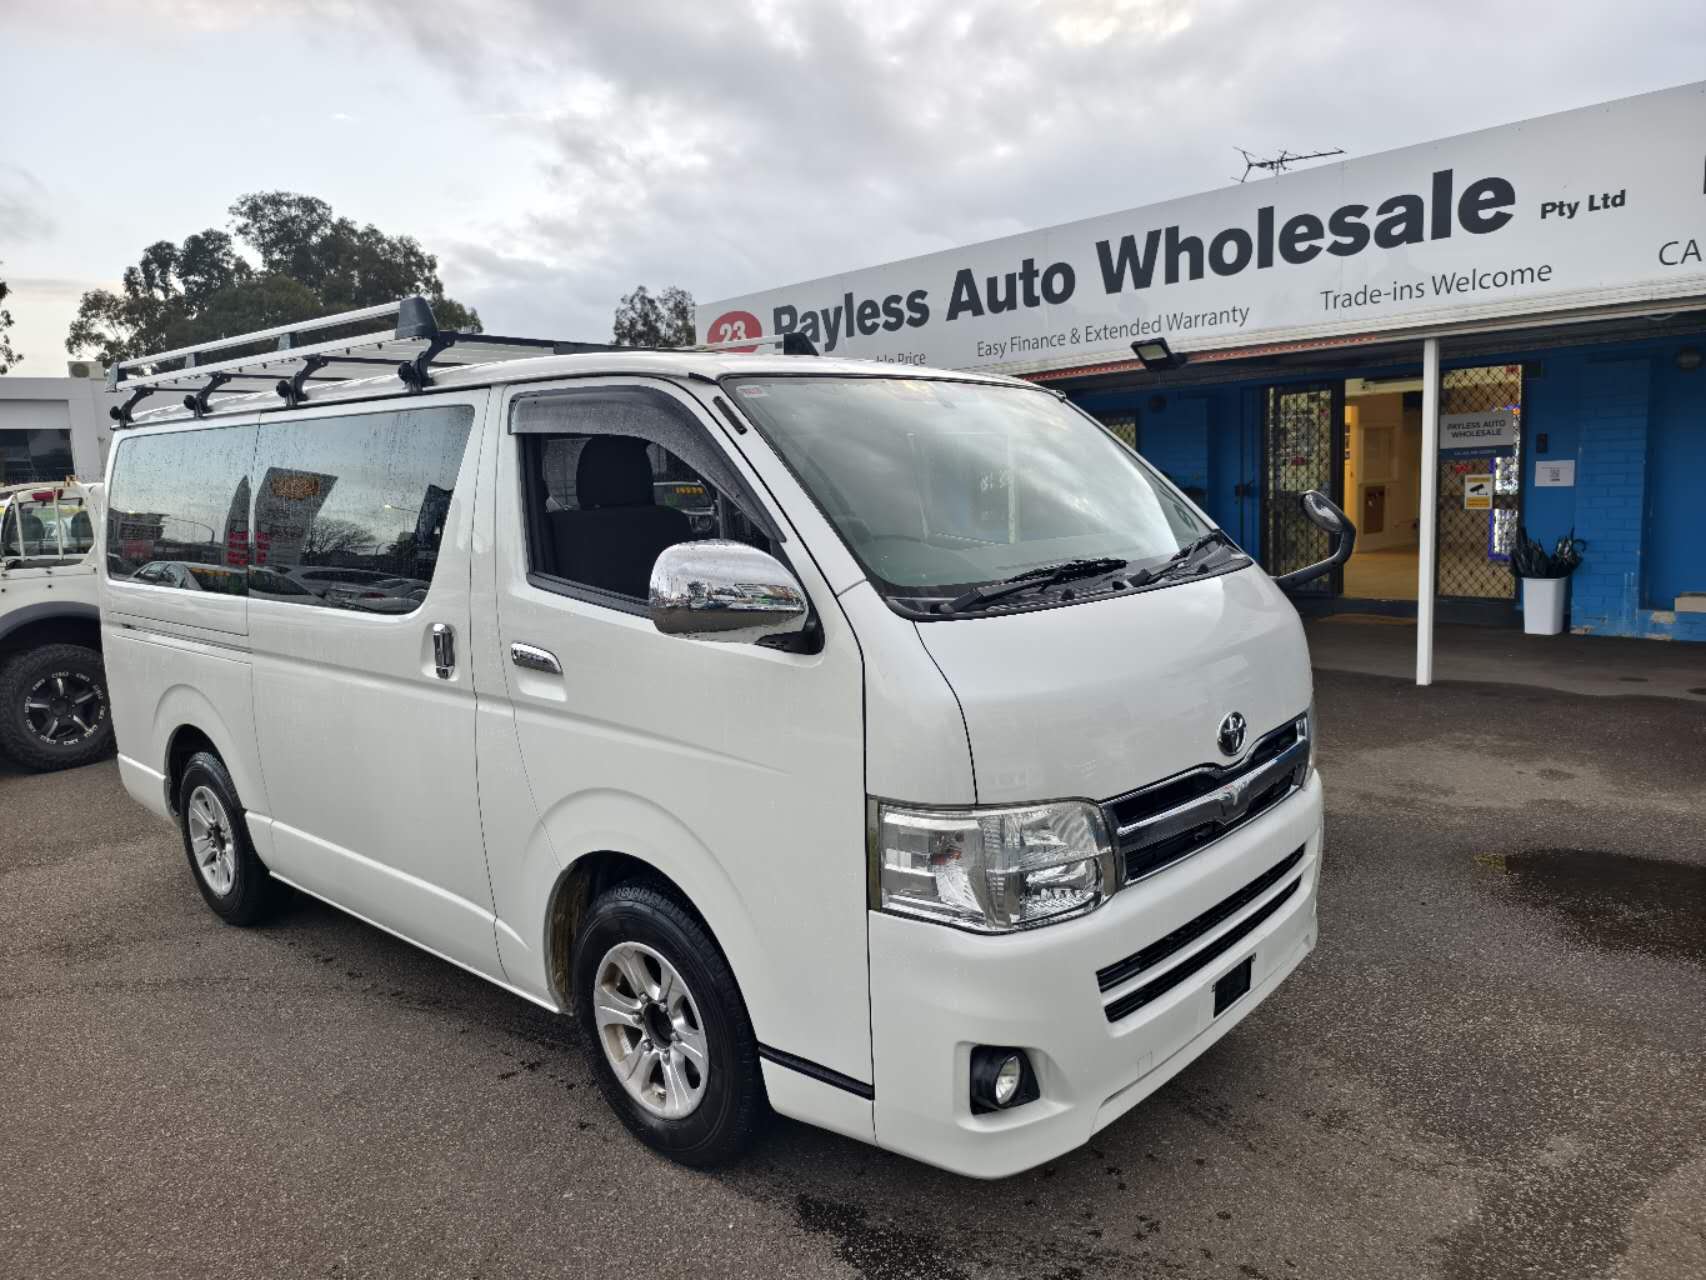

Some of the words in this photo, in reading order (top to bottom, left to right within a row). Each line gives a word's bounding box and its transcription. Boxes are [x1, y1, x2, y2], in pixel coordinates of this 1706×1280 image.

[719, 320, 747, 344] 23
[773, 290, 930, 352] Payless
[946, 258, 1075, 321] Auto
[1095, 168, 1516, 294] Wholesale
[1540, 200, 1580, 219] Pty
[1587, 189, 1626, 212] Ltd
[1320, 281, 1425, 310] Trade-ins
[1431, 264, 1553, 296] Welcome
[976, 338, 1007, 360] Easy
[1010, 332, 1066, 353] Finance
[1070, 327, 1081, 345] &
[1085, 314, 1162, 344] Extended
[1166, 306, 1250, 331] Warranty
[897, 352, 926, 366] Price
[1451, 428, 1503, 438] WHOLESALE
[1483, 419, 1506, 428] AUTO
